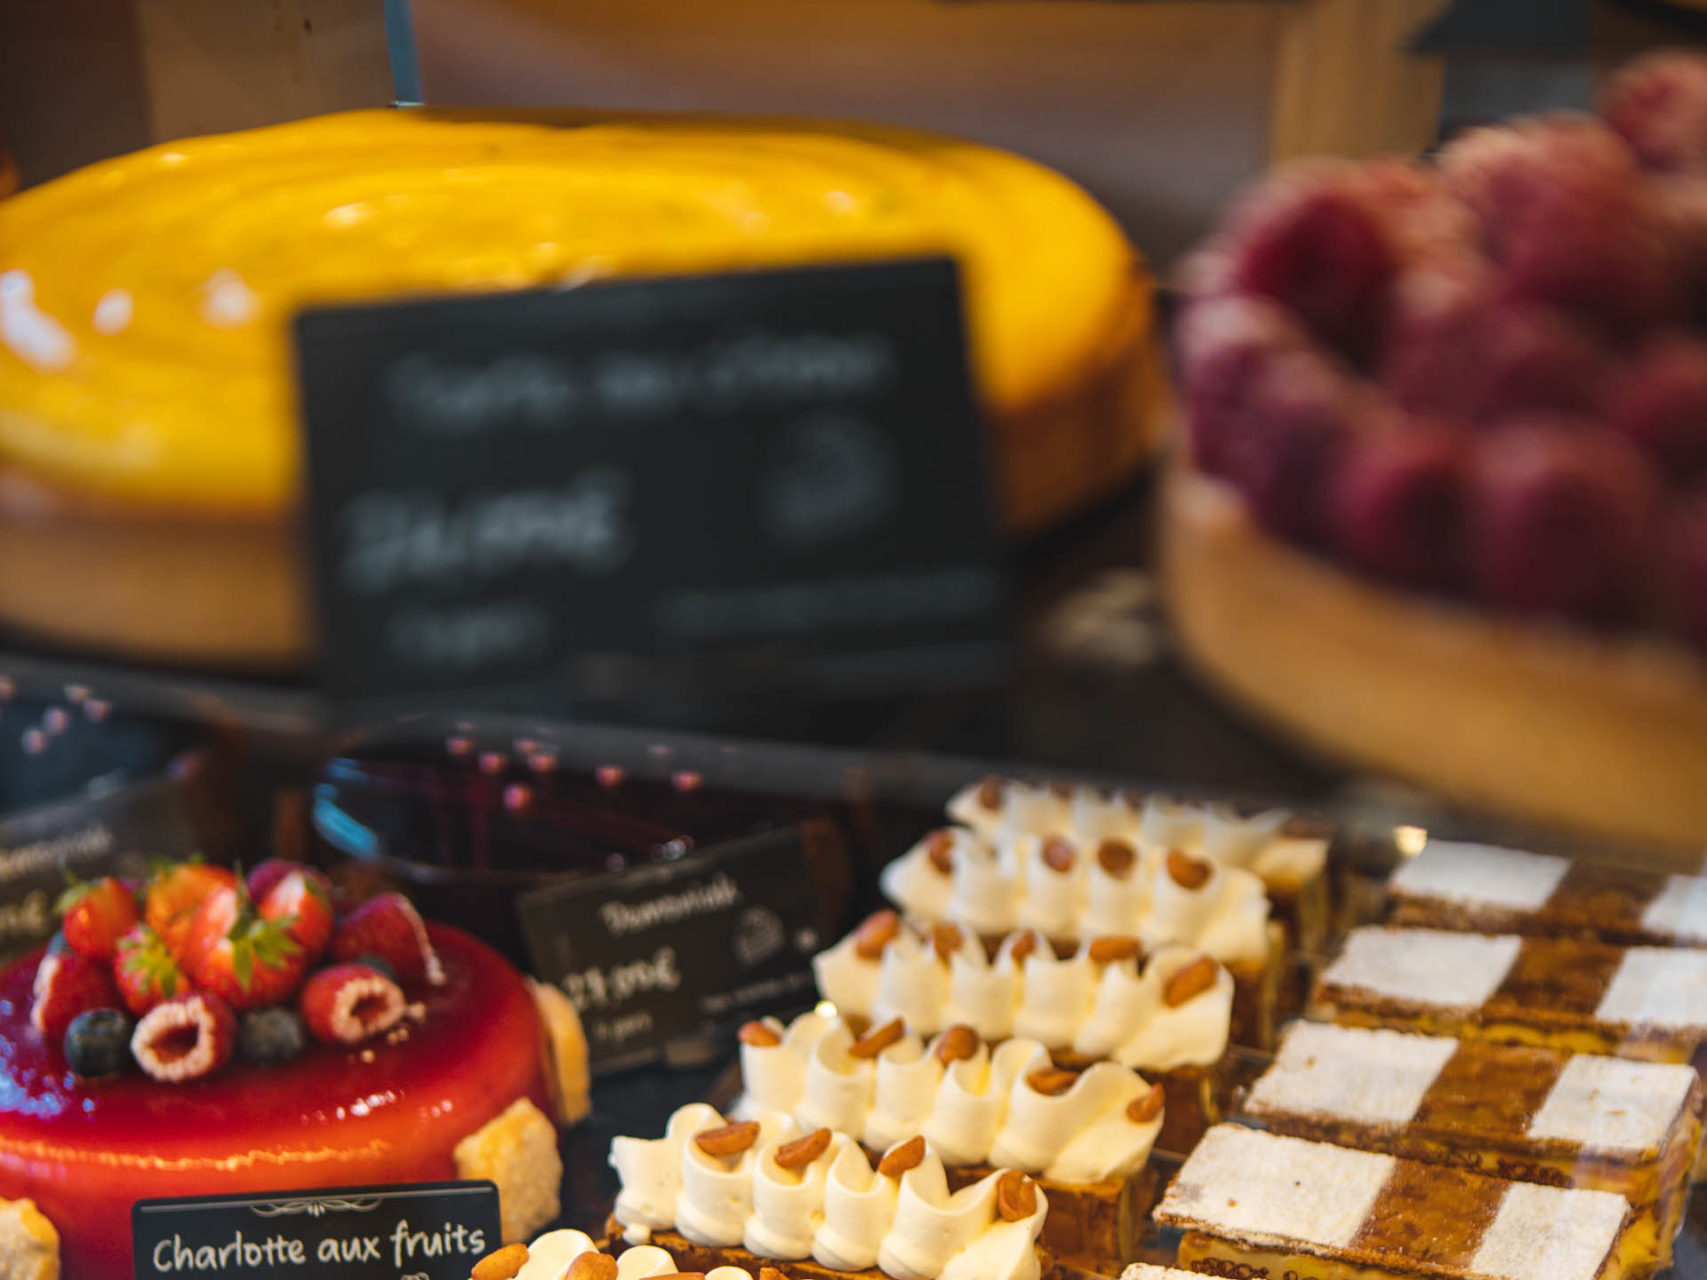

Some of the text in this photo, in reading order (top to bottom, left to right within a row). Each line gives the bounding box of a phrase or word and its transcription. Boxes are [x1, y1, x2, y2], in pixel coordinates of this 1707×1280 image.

[153, 1218, 487, 1272] Charlotte aux fruits
